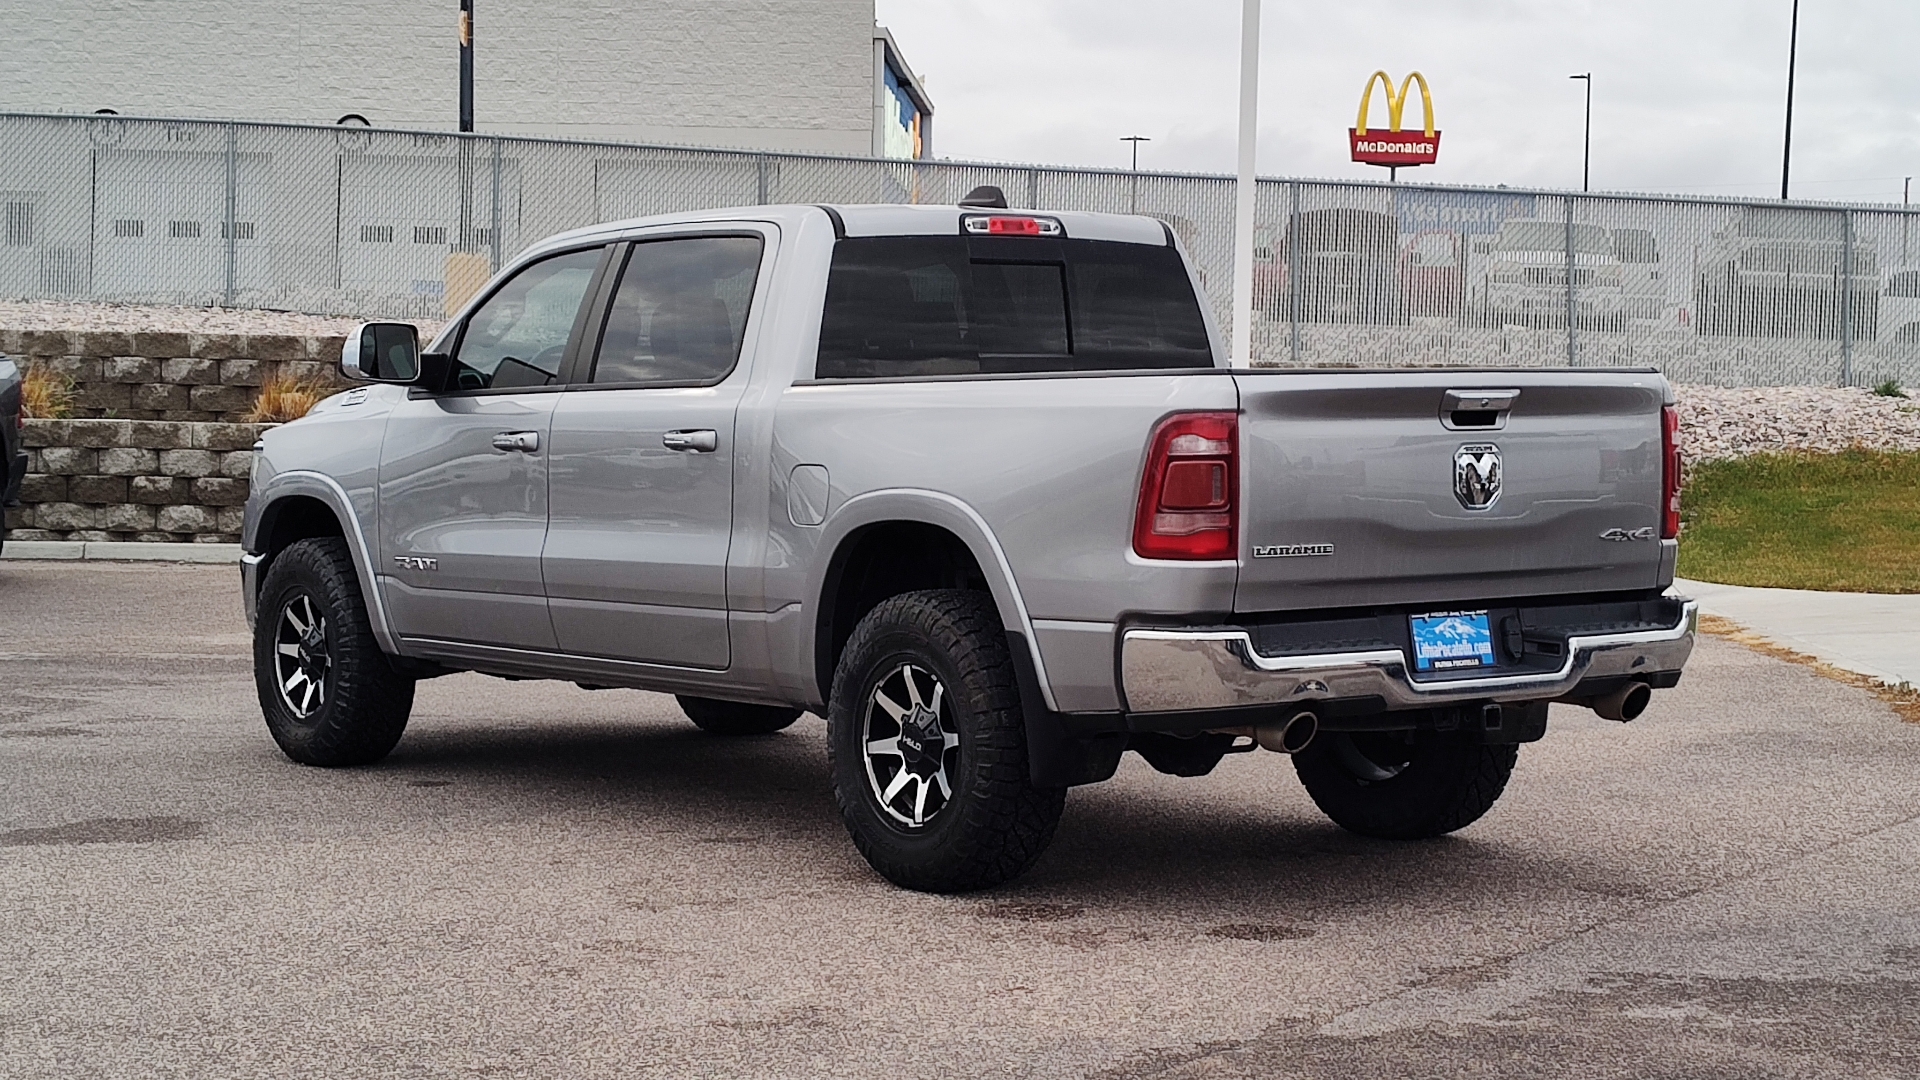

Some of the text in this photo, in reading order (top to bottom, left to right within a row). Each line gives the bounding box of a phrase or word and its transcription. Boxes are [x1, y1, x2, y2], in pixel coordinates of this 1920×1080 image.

[1356, 141, 1434, 154] McDonald's
[1253, 543, 1334, 558] LARAMIE
[394, 556, 437, 570] RAM
